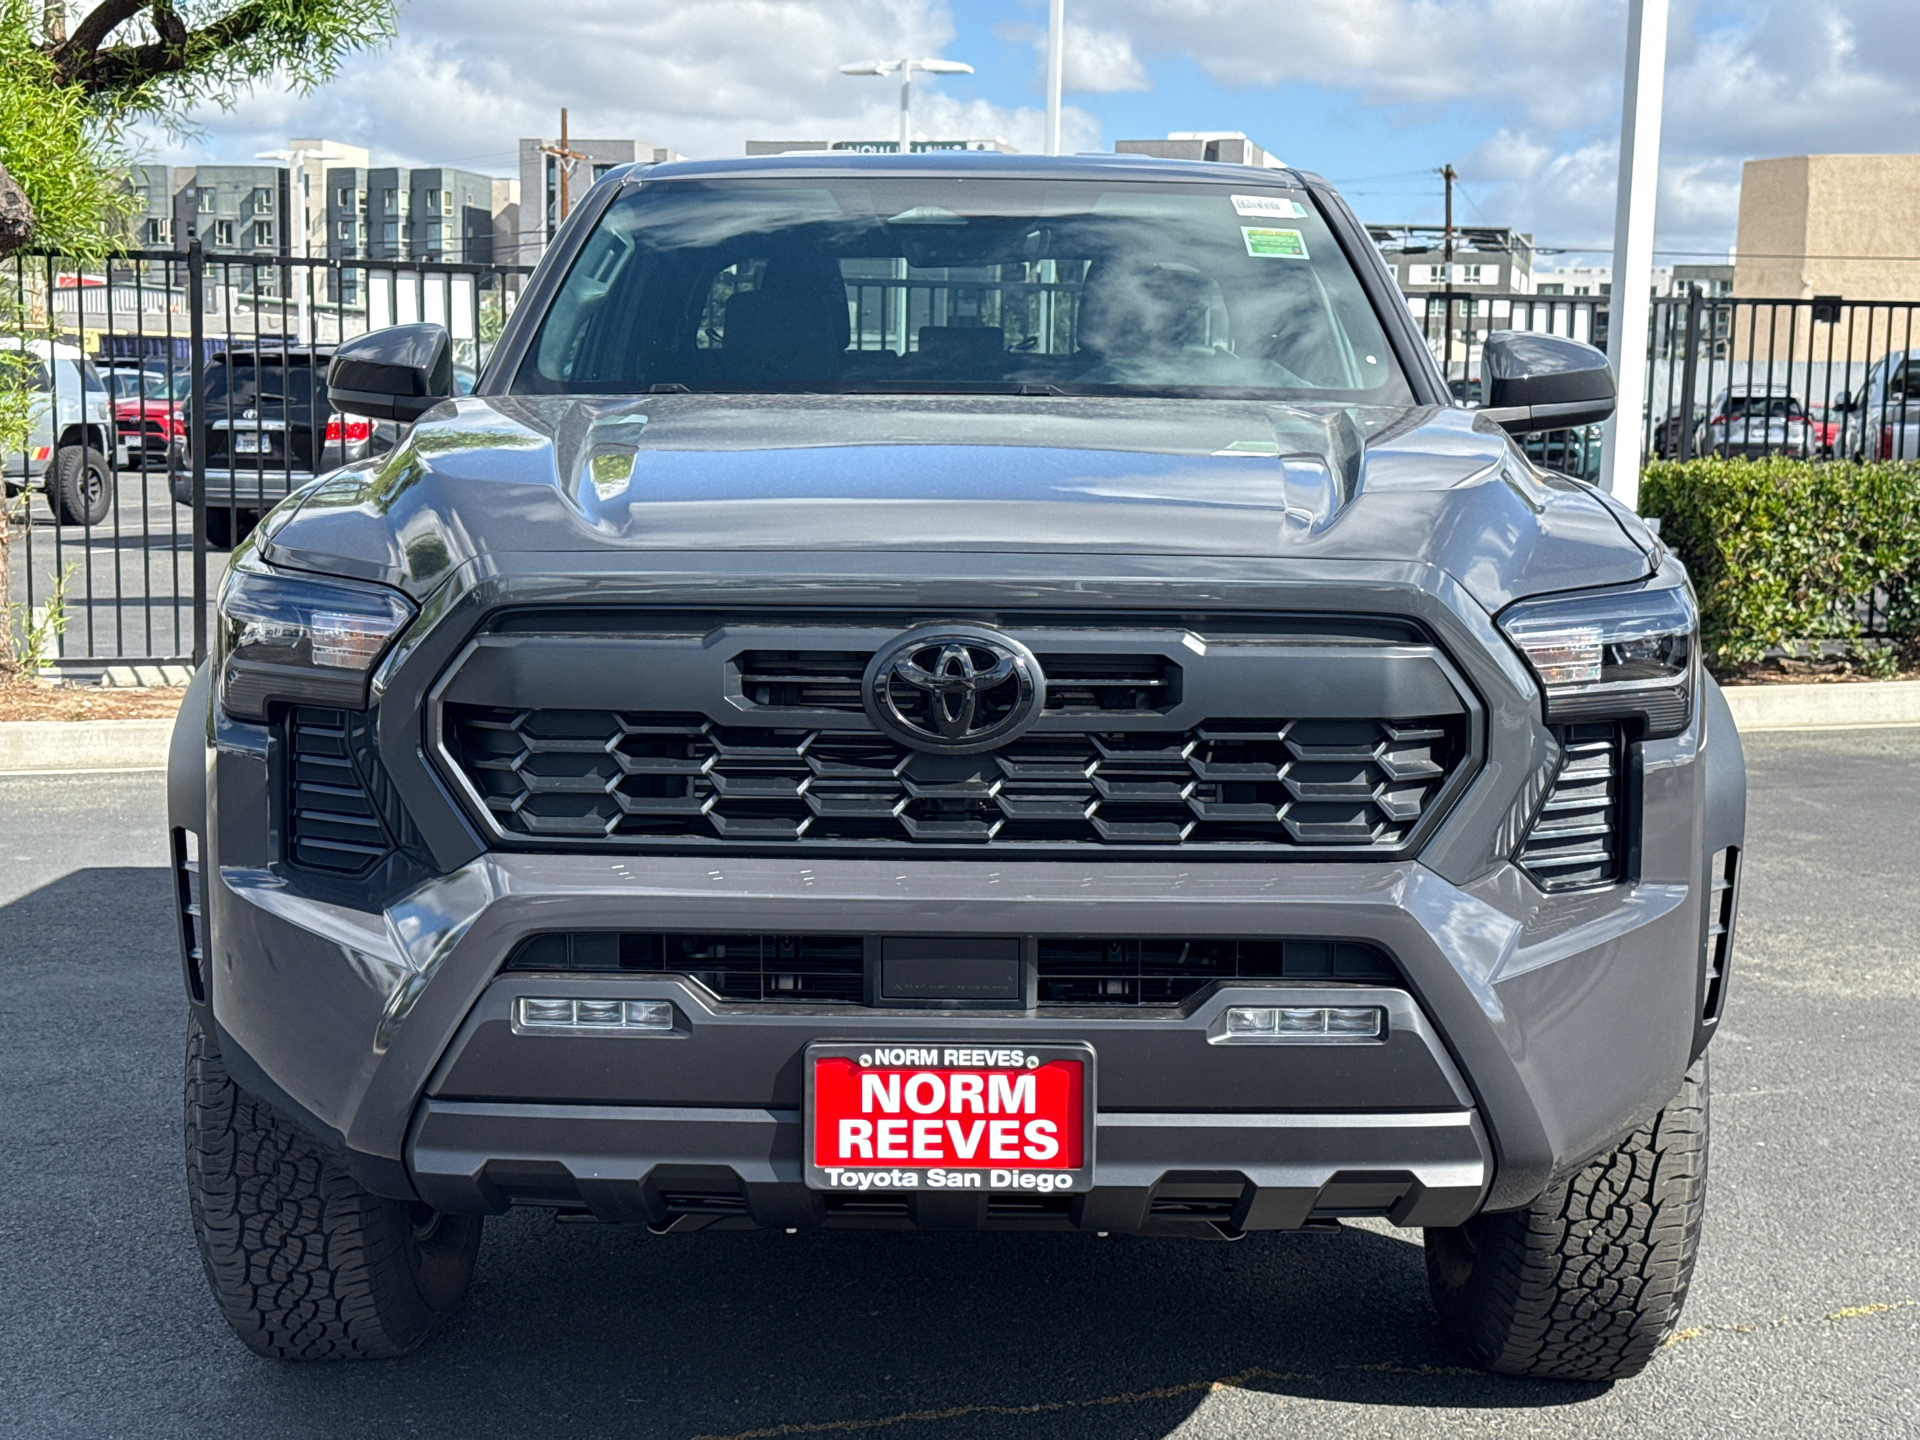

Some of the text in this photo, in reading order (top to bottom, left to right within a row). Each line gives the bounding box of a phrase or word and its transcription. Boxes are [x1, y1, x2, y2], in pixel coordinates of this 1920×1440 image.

[875, 1049, 1024, 1066] NORM REEVES
[862, 1073, 1036, 1114] NORM
[838, 1119, 1059, 1160] REEVES
[824, 1167, 1073, 1192] Toyota San Diego
